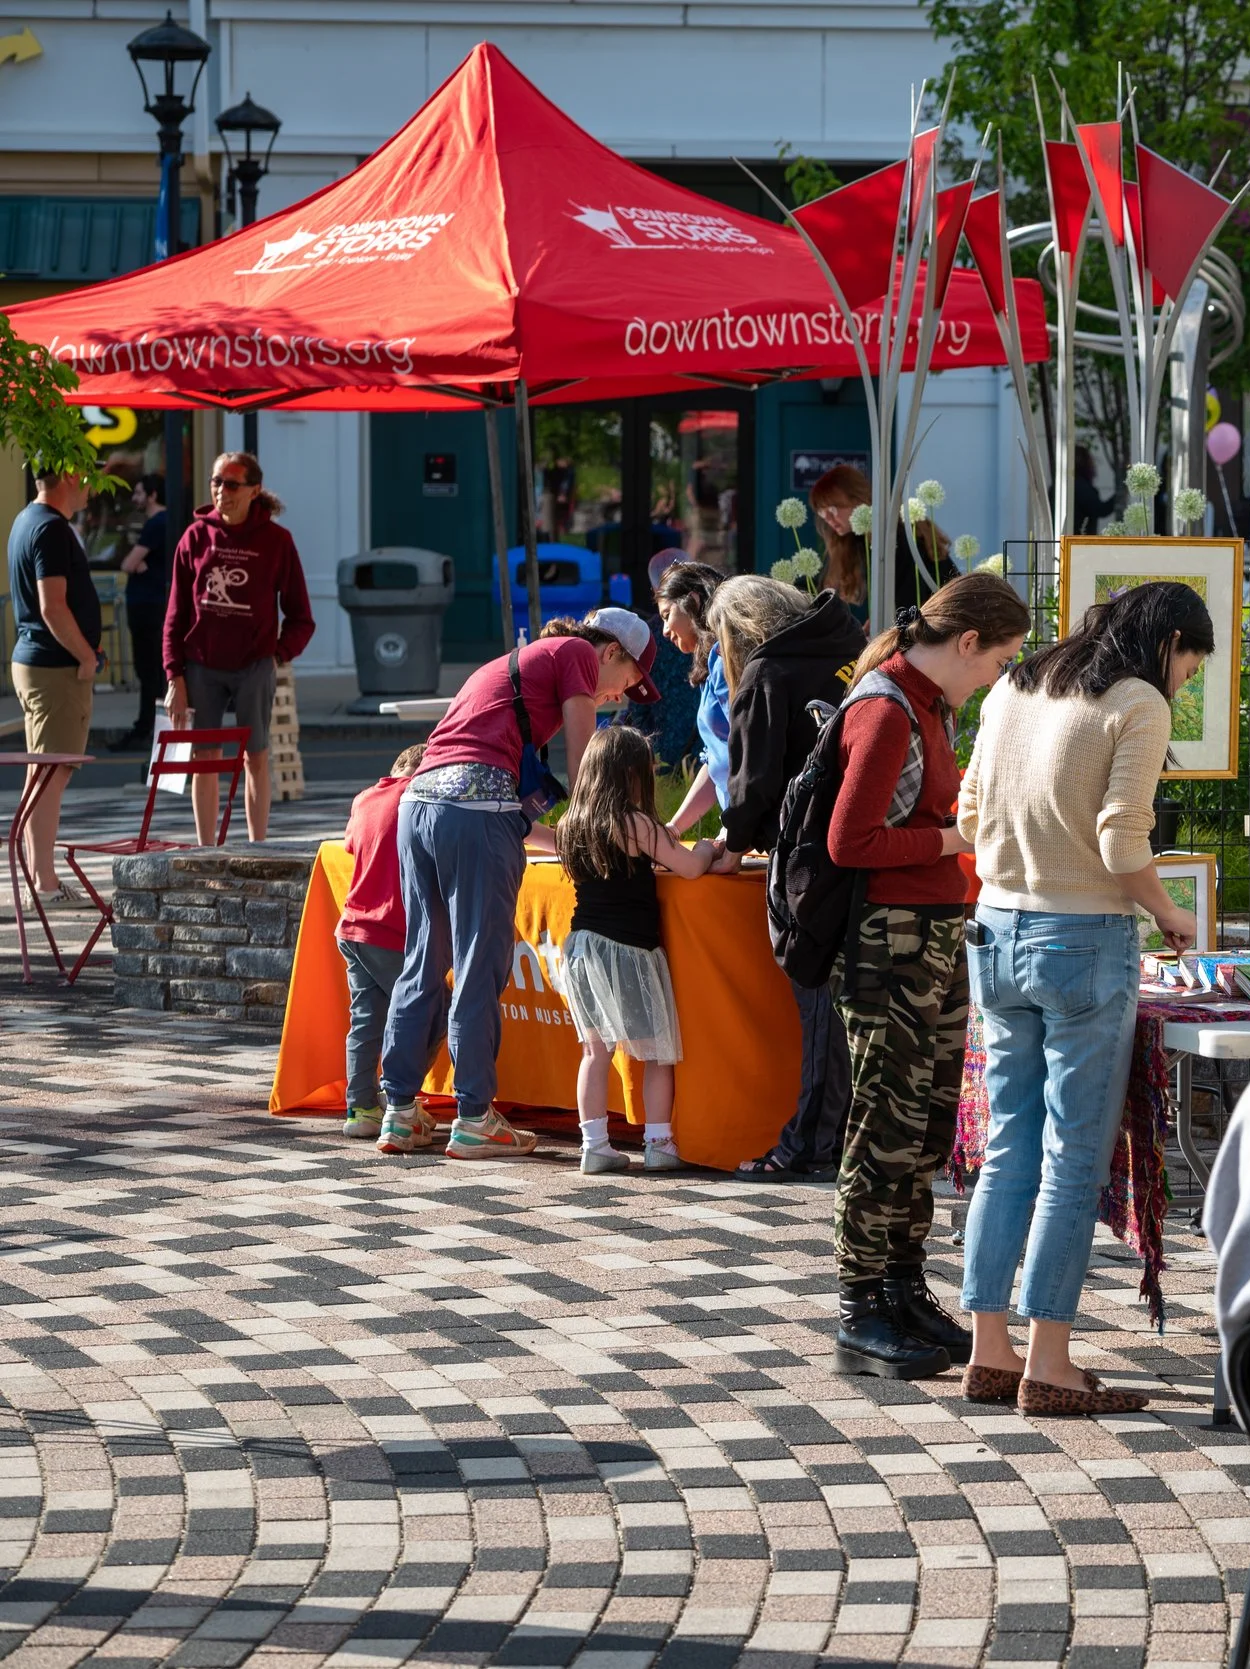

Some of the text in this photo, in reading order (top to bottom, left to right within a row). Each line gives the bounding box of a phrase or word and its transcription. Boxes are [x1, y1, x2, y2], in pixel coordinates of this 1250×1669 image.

[324, 212, 455, 239] DOWNTOWN
[615, 206, 733, 227] DOWNTOWN
[303, 227, 441, 259] STORRS
[633, 220, 757, 244] STORRS
